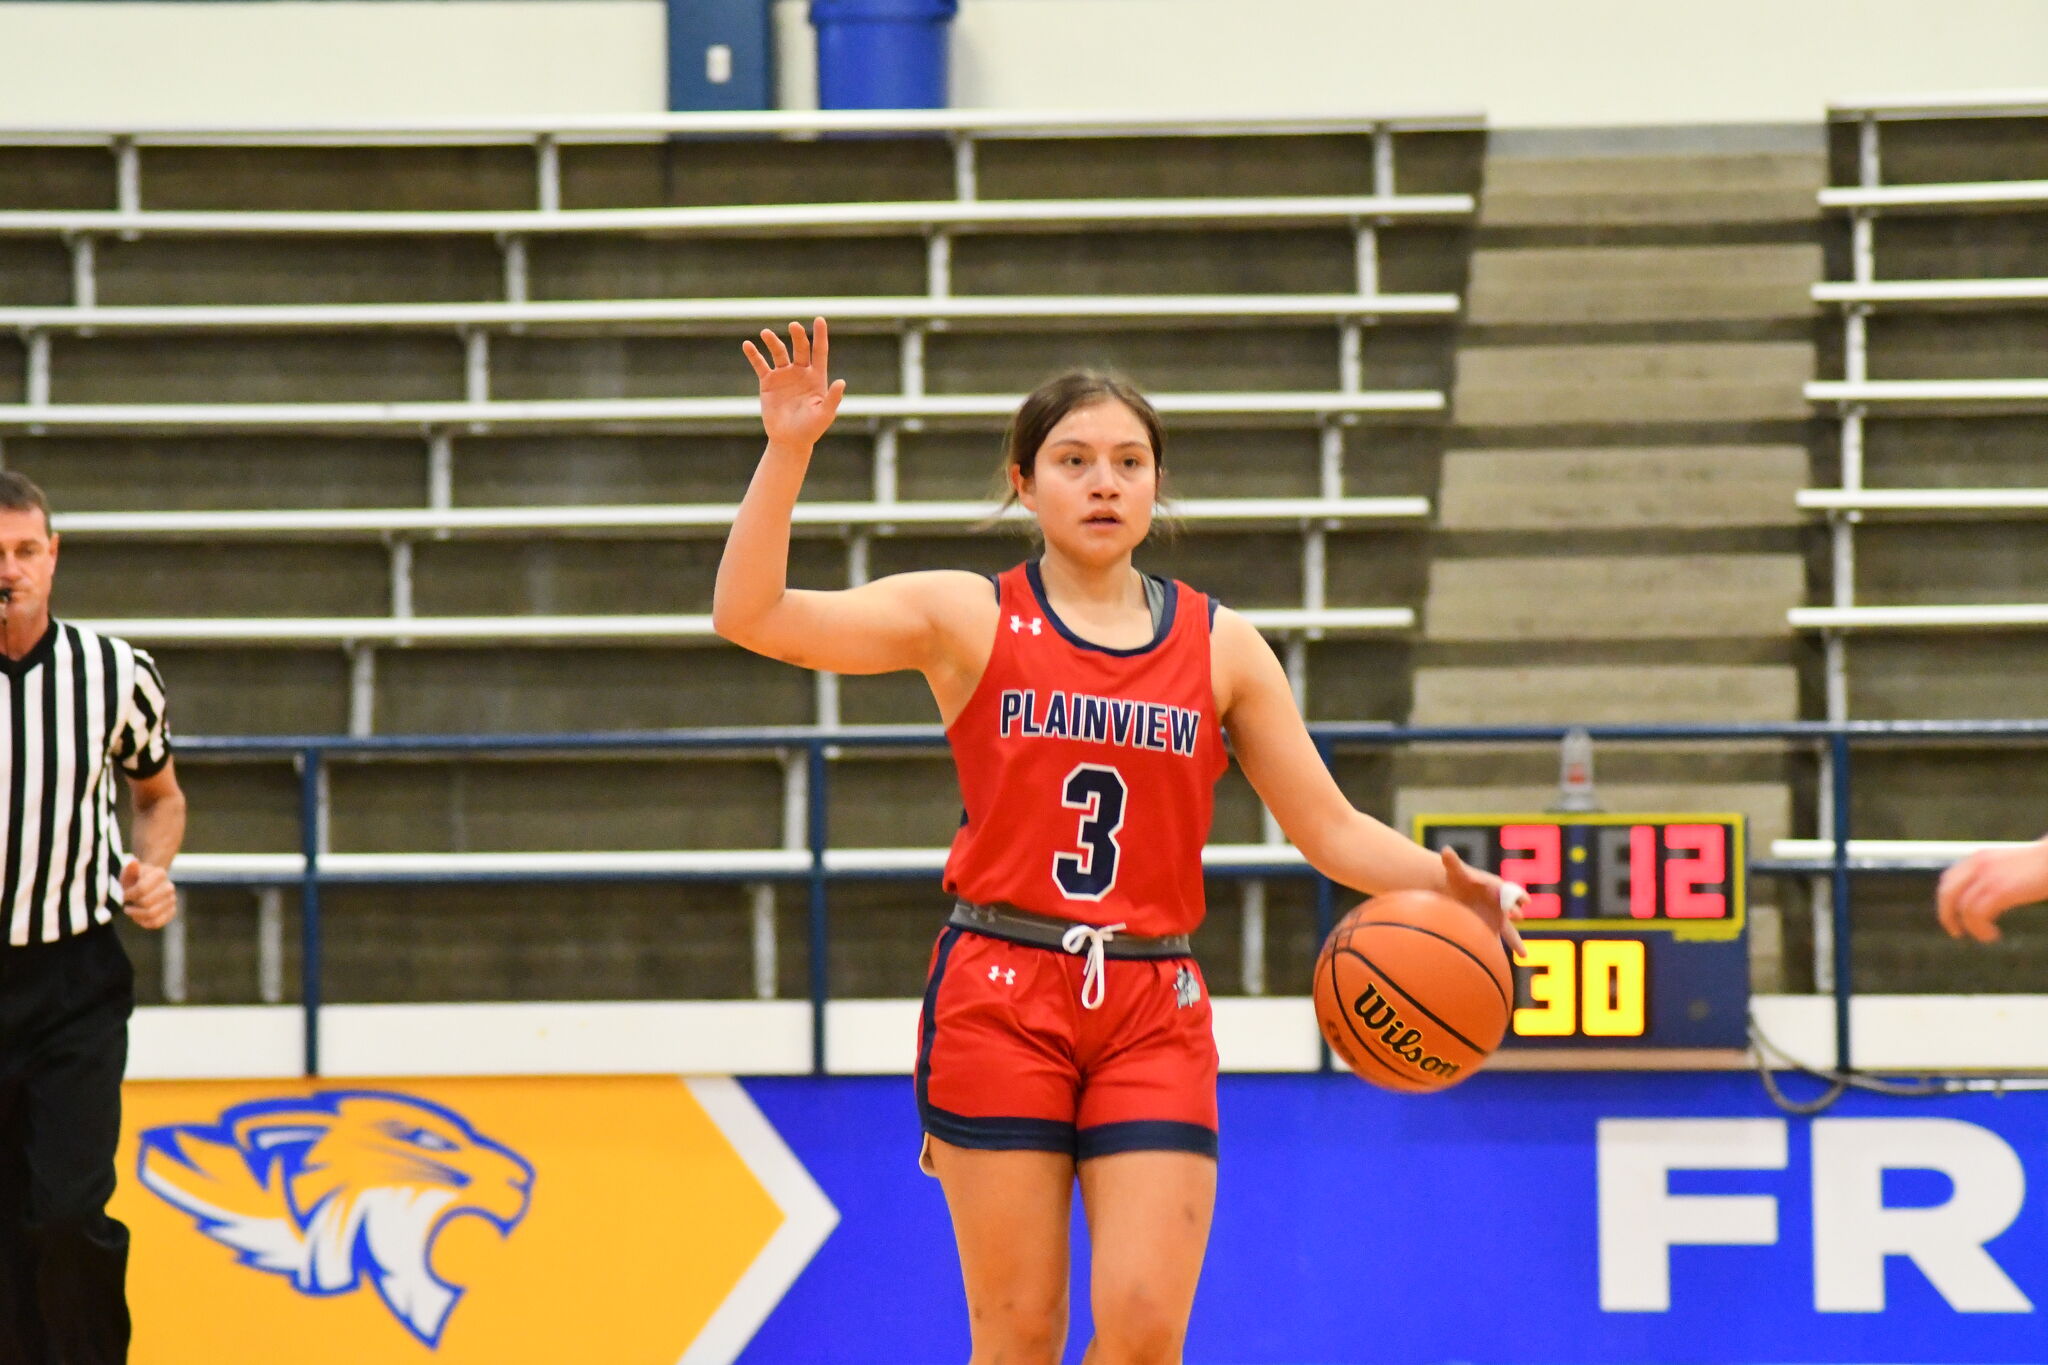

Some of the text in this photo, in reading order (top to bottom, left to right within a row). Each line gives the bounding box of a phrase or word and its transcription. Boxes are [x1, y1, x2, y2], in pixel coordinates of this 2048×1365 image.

[1000, 689, 1200, 757] PLAINVIEW
[1052, 762, 1128, 902] 3
[1500, 824, 1726, 918] 2:12
[1354, 982, 1461, 1079] Wilson
[1513, 939, 1645, 1036] 30
[1597, 1117, 2034, 1313] FR
